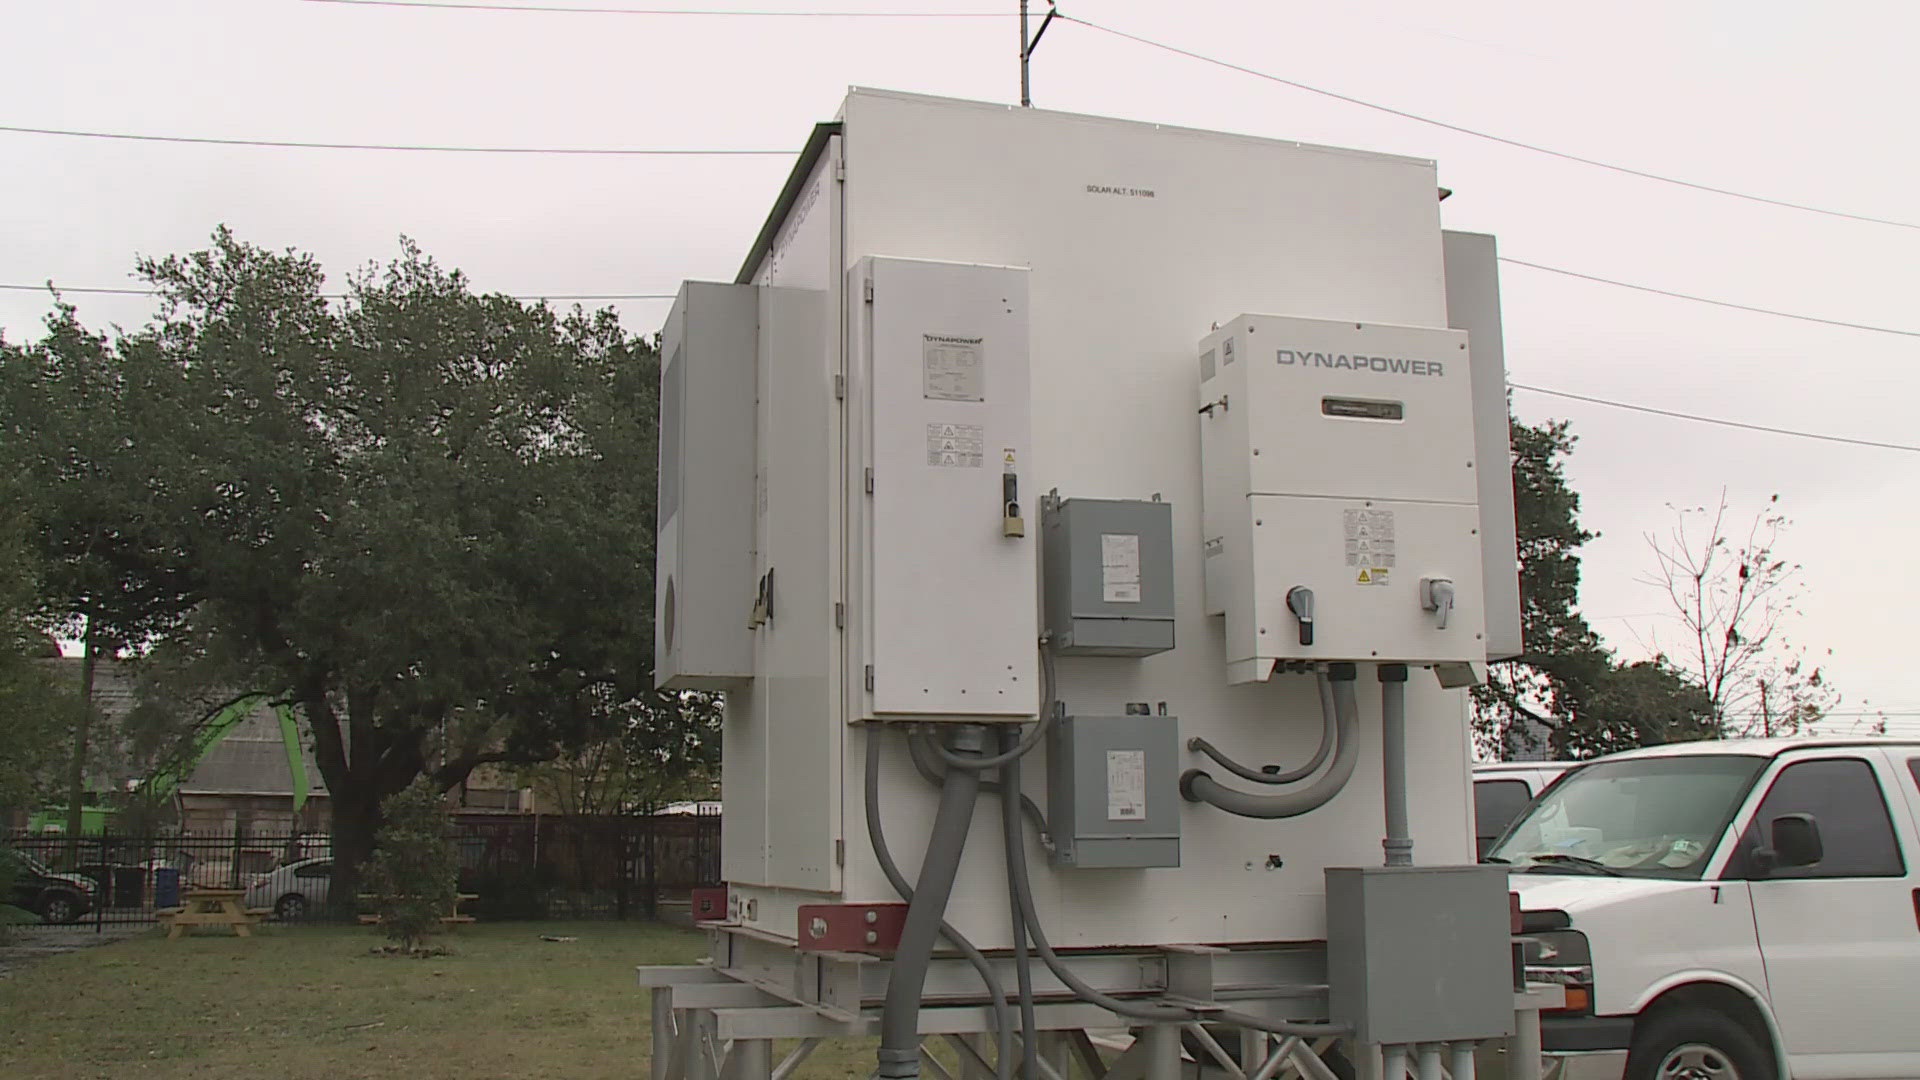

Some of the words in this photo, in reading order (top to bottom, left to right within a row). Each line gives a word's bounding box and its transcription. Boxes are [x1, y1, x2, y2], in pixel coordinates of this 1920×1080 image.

[1086, 184, 1112, 194] SOLAR
[926, 335, 982, 345] DYNAPOWER
[1276, 349, 1444, 377] DYNAPOWER
